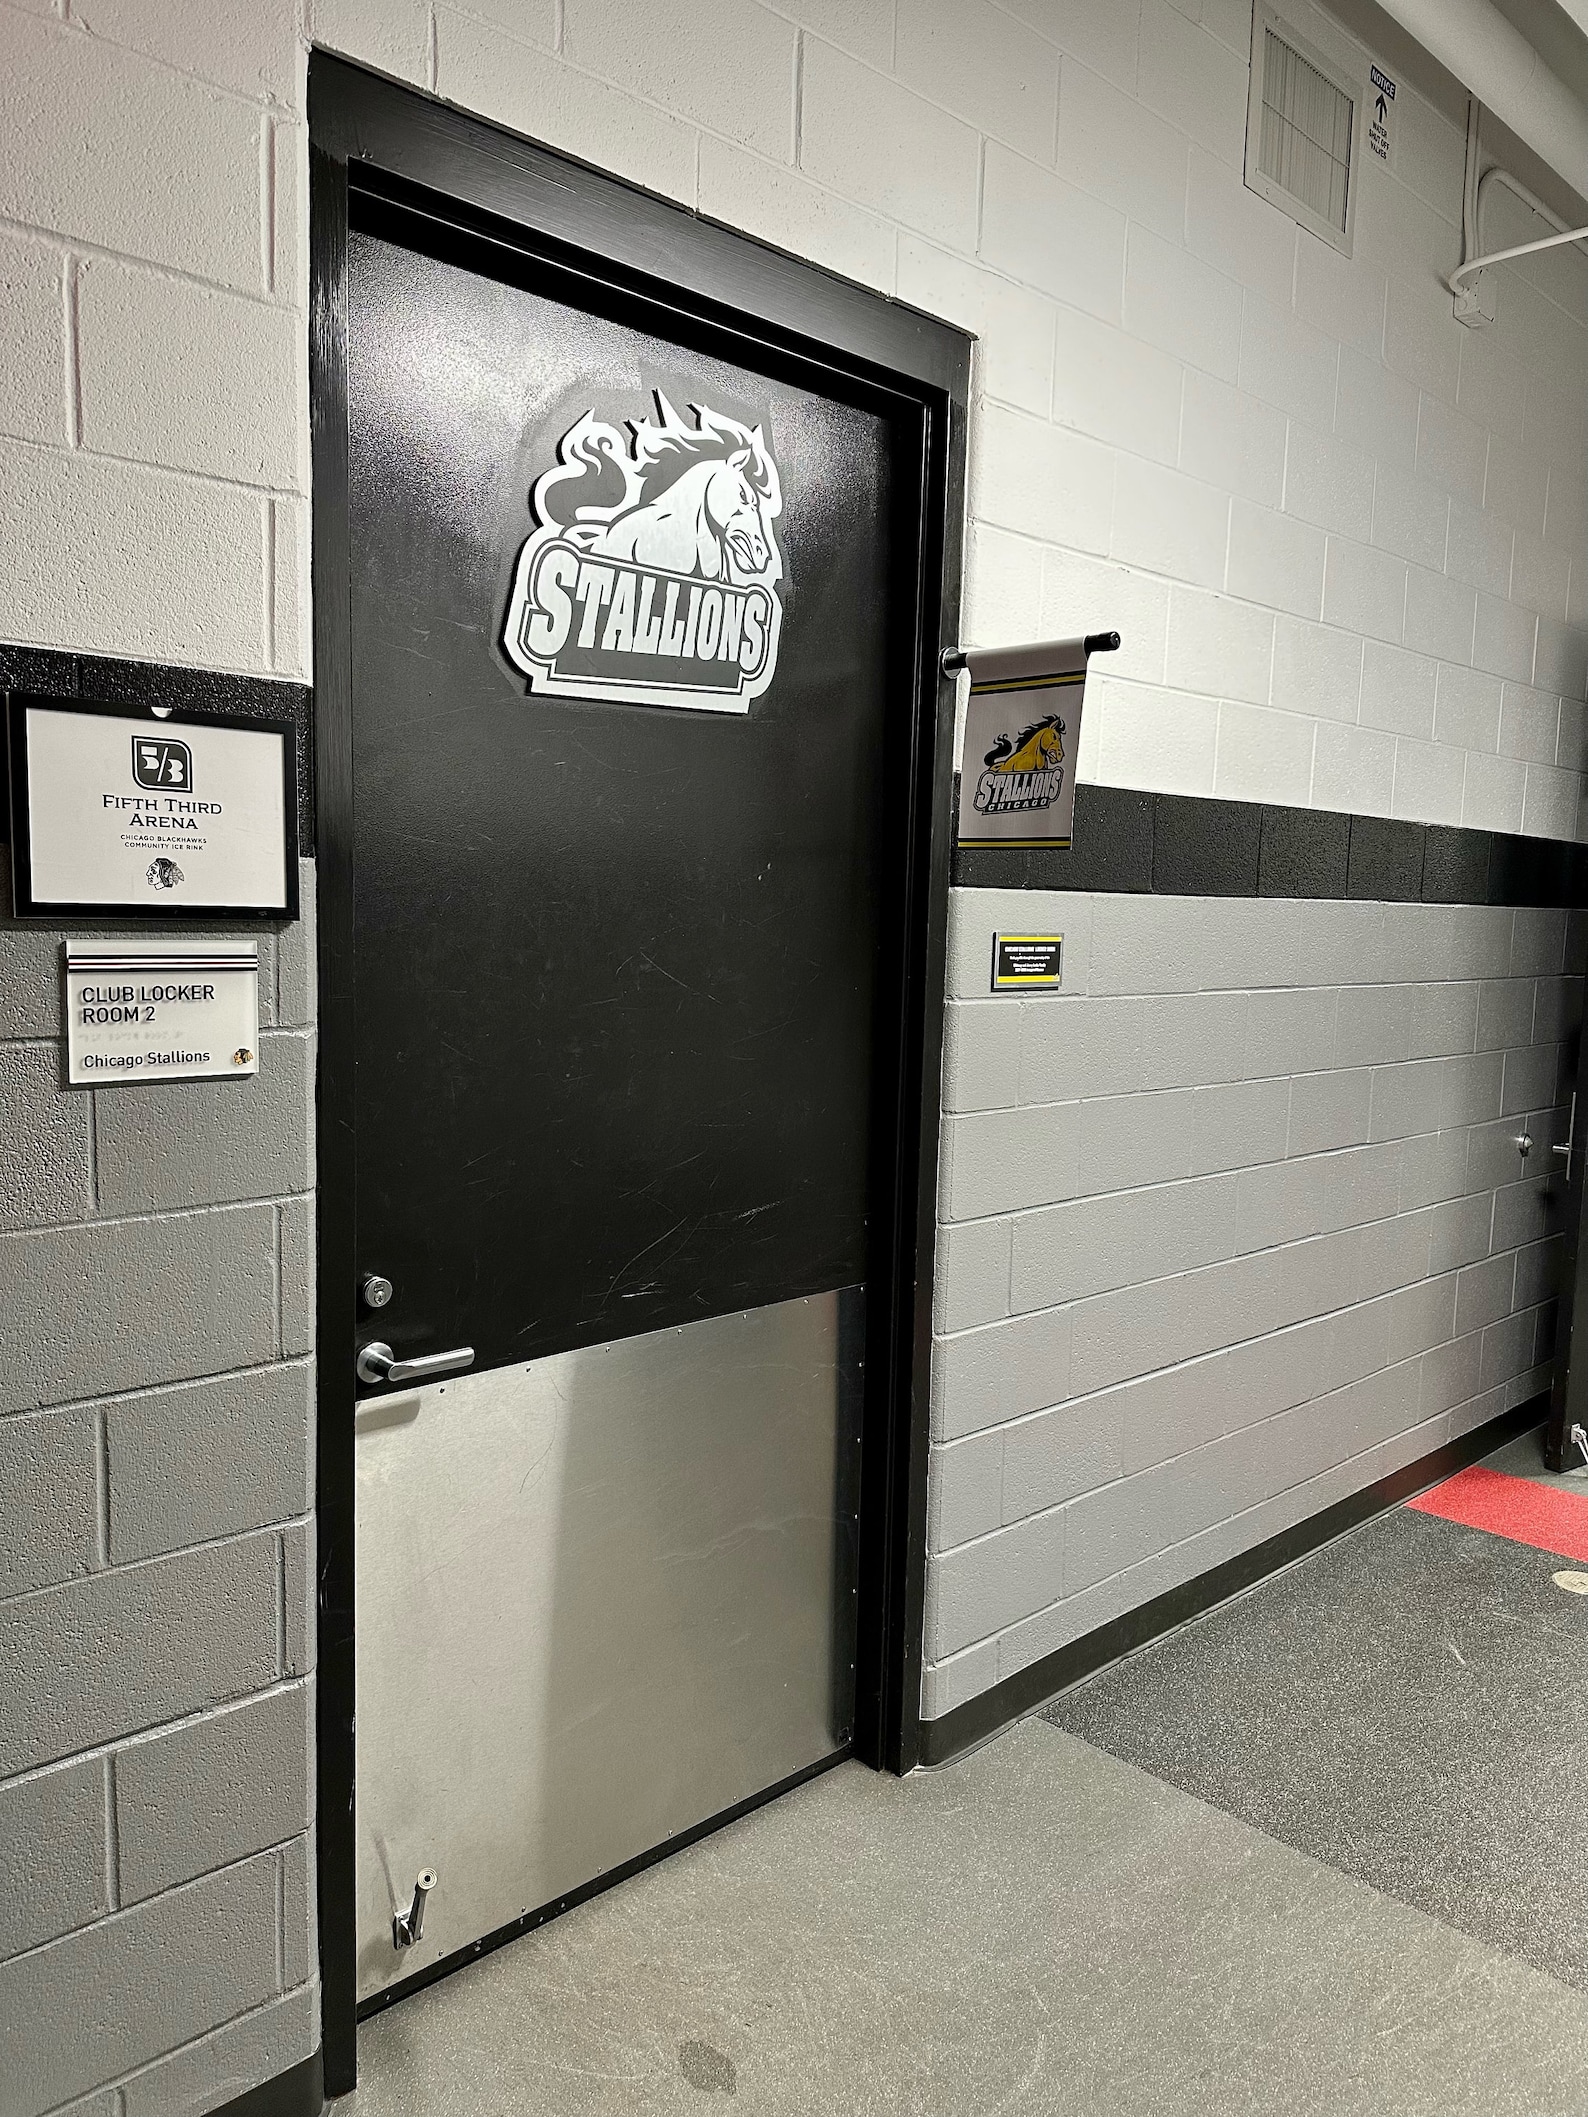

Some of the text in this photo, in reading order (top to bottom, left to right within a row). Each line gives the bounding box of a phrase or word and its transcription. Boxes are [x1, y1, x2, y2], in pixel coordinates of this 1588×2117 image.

[1371, 68, 1395, 97] NOTICE
[1373, 120, 1387, 138] WATER
[1369, 129, 1389, 150] SHUT OFF
[1371, 140, 1386, 159] VALVES
[527, 549, 767, 671] STALLIONS
[977, 769, 1062, 808] STALLIONS
[102, 795, 222, 815] FIFTH THIRD
[988, 799, 1047, 811] CHICAGO
[129, 814, 198, 829] ARENA
[120, 834, 207, 844] CHICAGO BLACKHAWKS
[124, 842, 169, 850] COMMUNITY
[82, 985, 215, 1003] CLUB LOCKER
[83, 1006, 156, 1024] ROOM 2
[84, 1050, 210, 1069] Chicago Stallions
